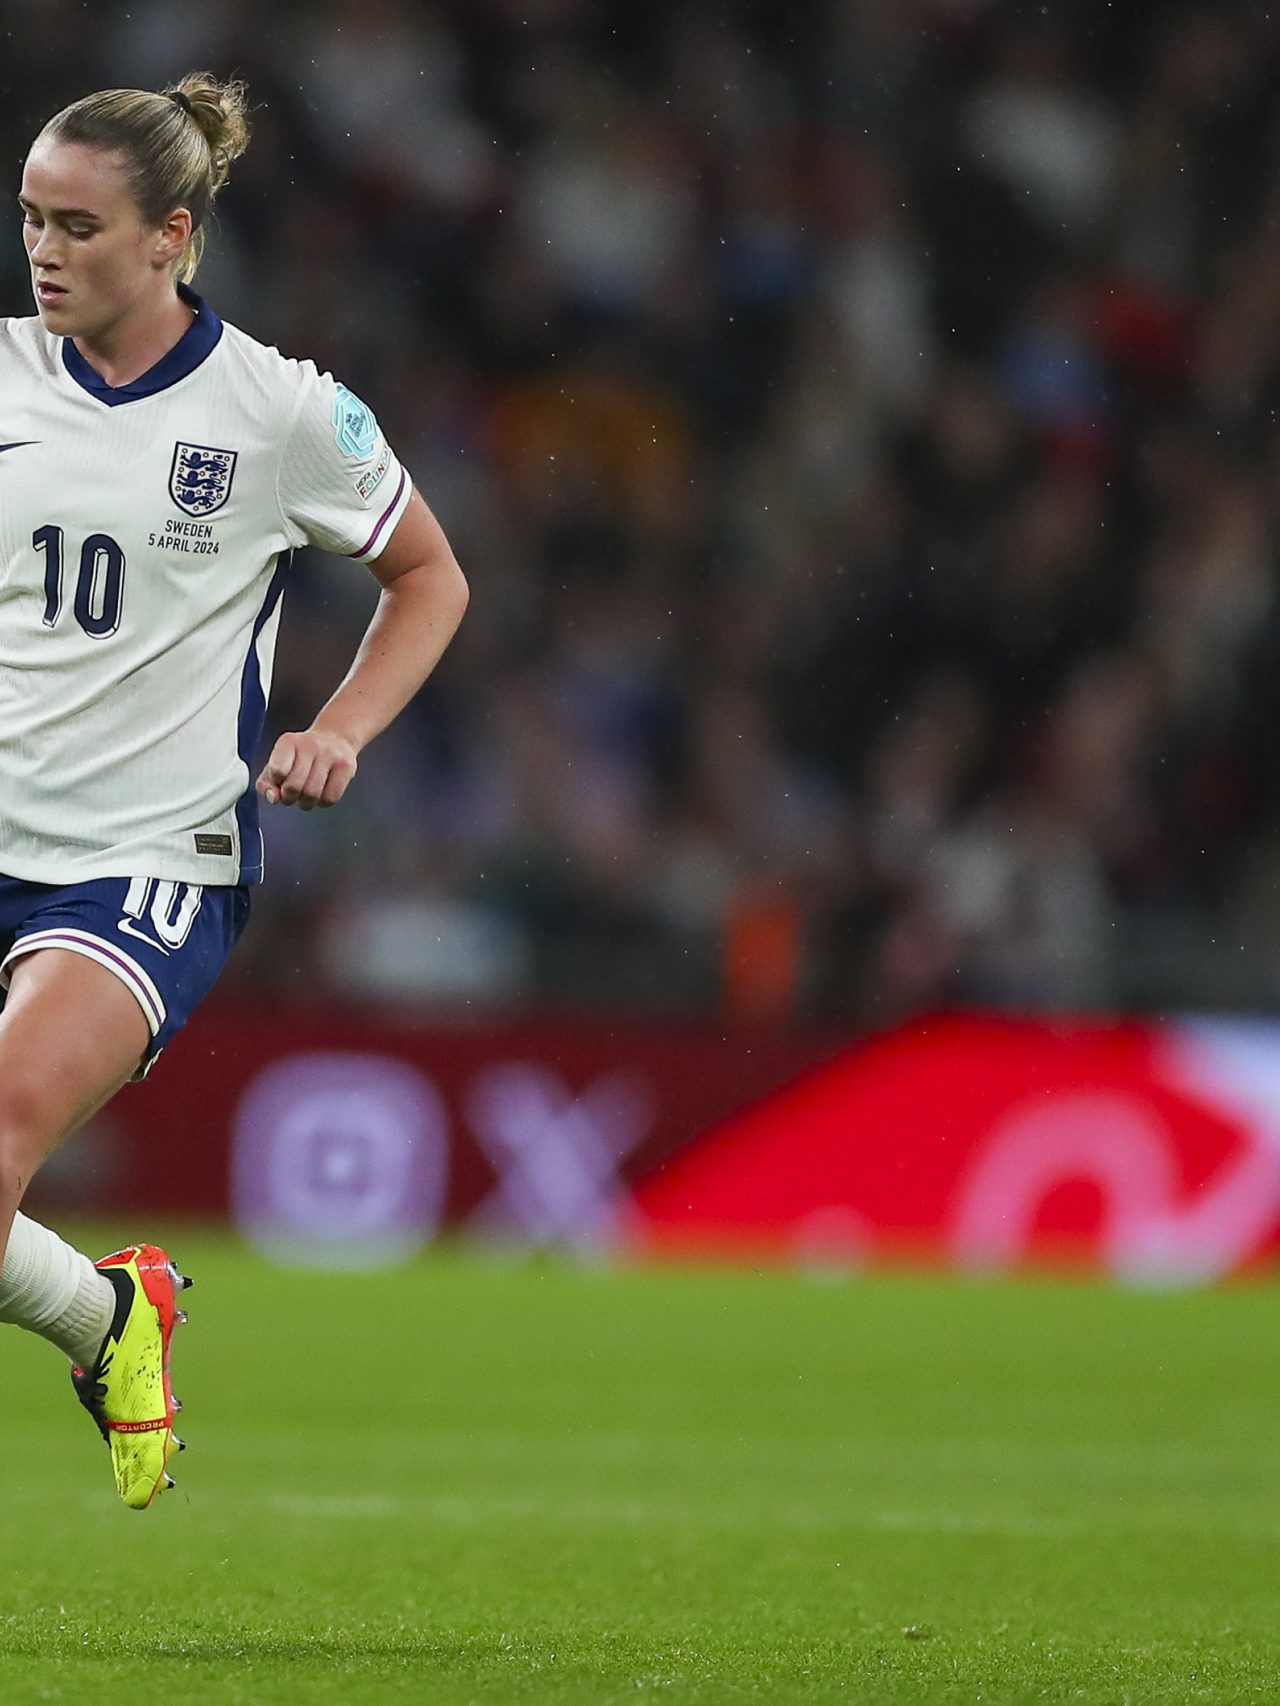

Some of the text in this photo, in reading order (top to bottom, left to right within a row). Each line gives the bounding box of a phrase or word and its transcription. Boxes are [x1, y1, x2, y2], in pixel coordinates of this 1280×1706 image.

[165, 519, 213, 538] SWEDEN
[148, 533, 220, 554] 5 APRIL 2024
[32, 524, 126, 640] 10
